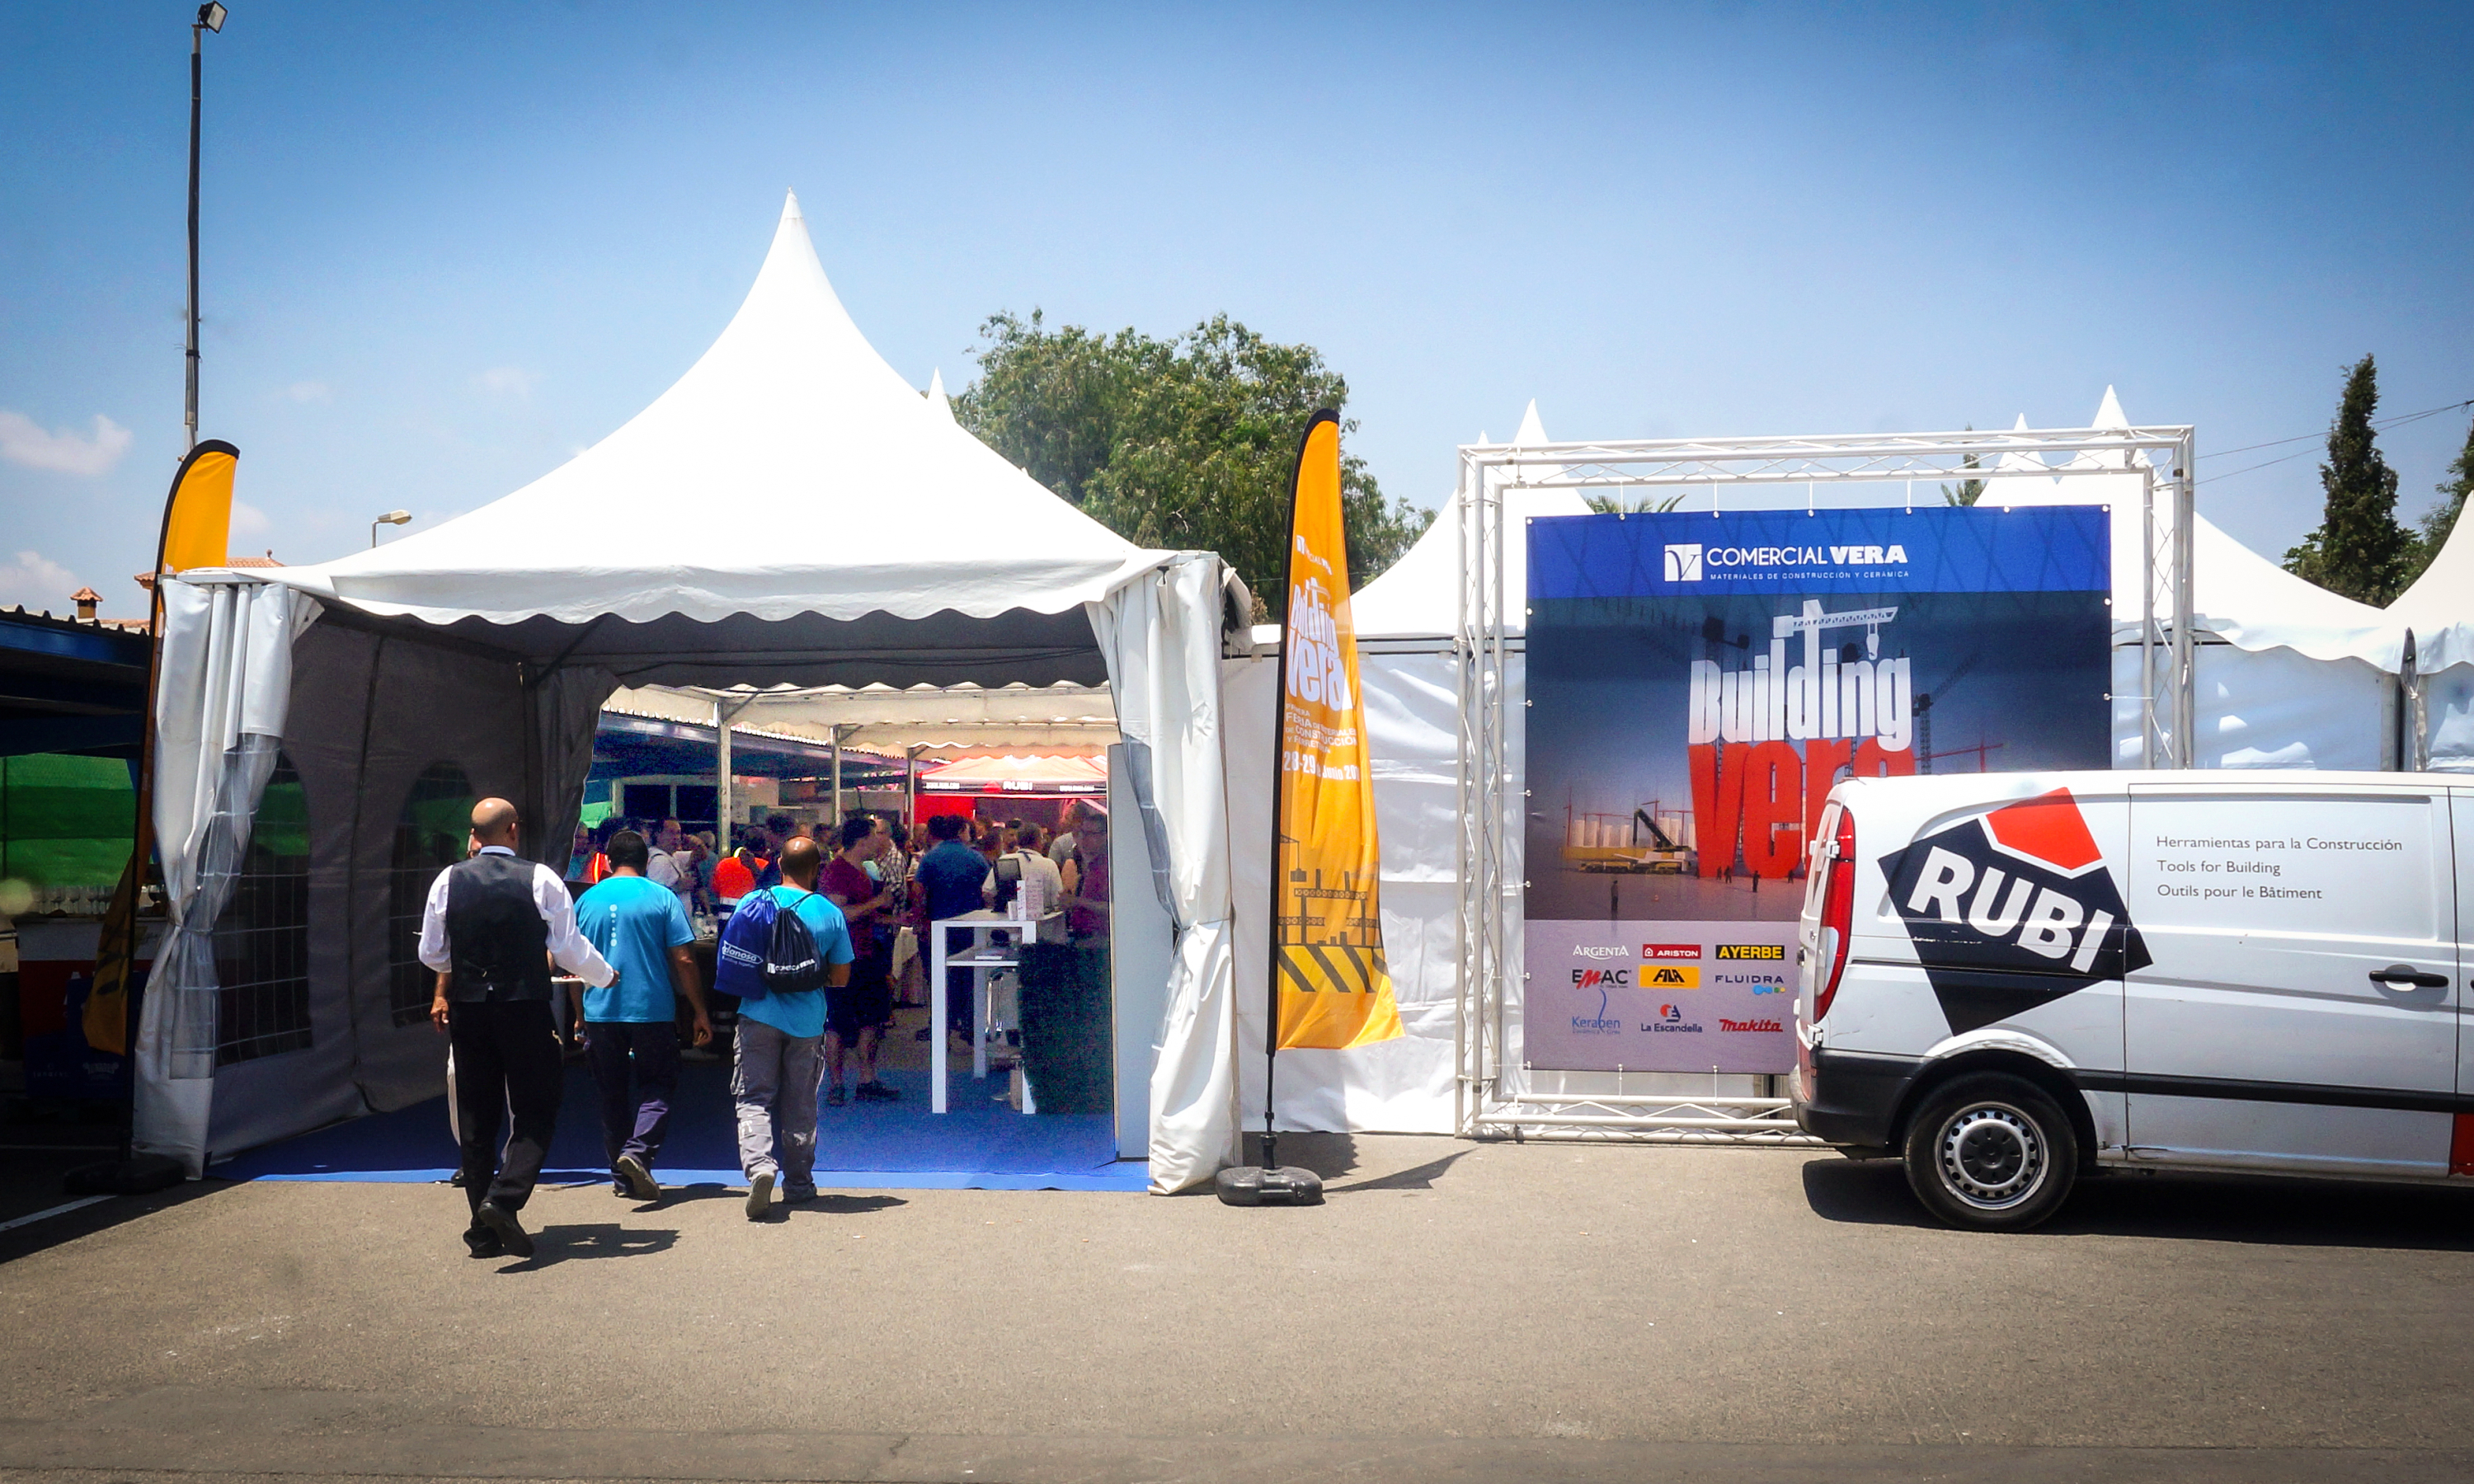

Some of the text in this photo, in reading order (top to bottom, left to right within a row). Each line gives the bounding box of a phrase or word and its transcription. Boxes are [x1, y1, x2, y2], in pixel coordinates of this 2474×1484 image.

[1706, 546, 1827, 566] COMERCIAL
[1829, 544, 1908, 565] VERA
[1688, 599, 1912, 752] Building
[1283, 751, 1315, 774] 28-29
[2157, 836, 2402, 852] Herramientas para la Construcción
[2157, 860, 2281, 876] Tools for Building
[2157, 884, 2322, 899] Outils pour le Bâtiment
[1907, 846, 2114, 973] RUBI
[1573, 945, 1629, 960] ARGENTA
[1719, 946, 1782, 959] AYERBE
[1572, 969, 1629, 989] EMAC
[1653, 969, 1685, 983] FILA
[1715, 975, 1785, 984] FLUIDRA
[1641, 1022, 1703, 1033] La Escandella
